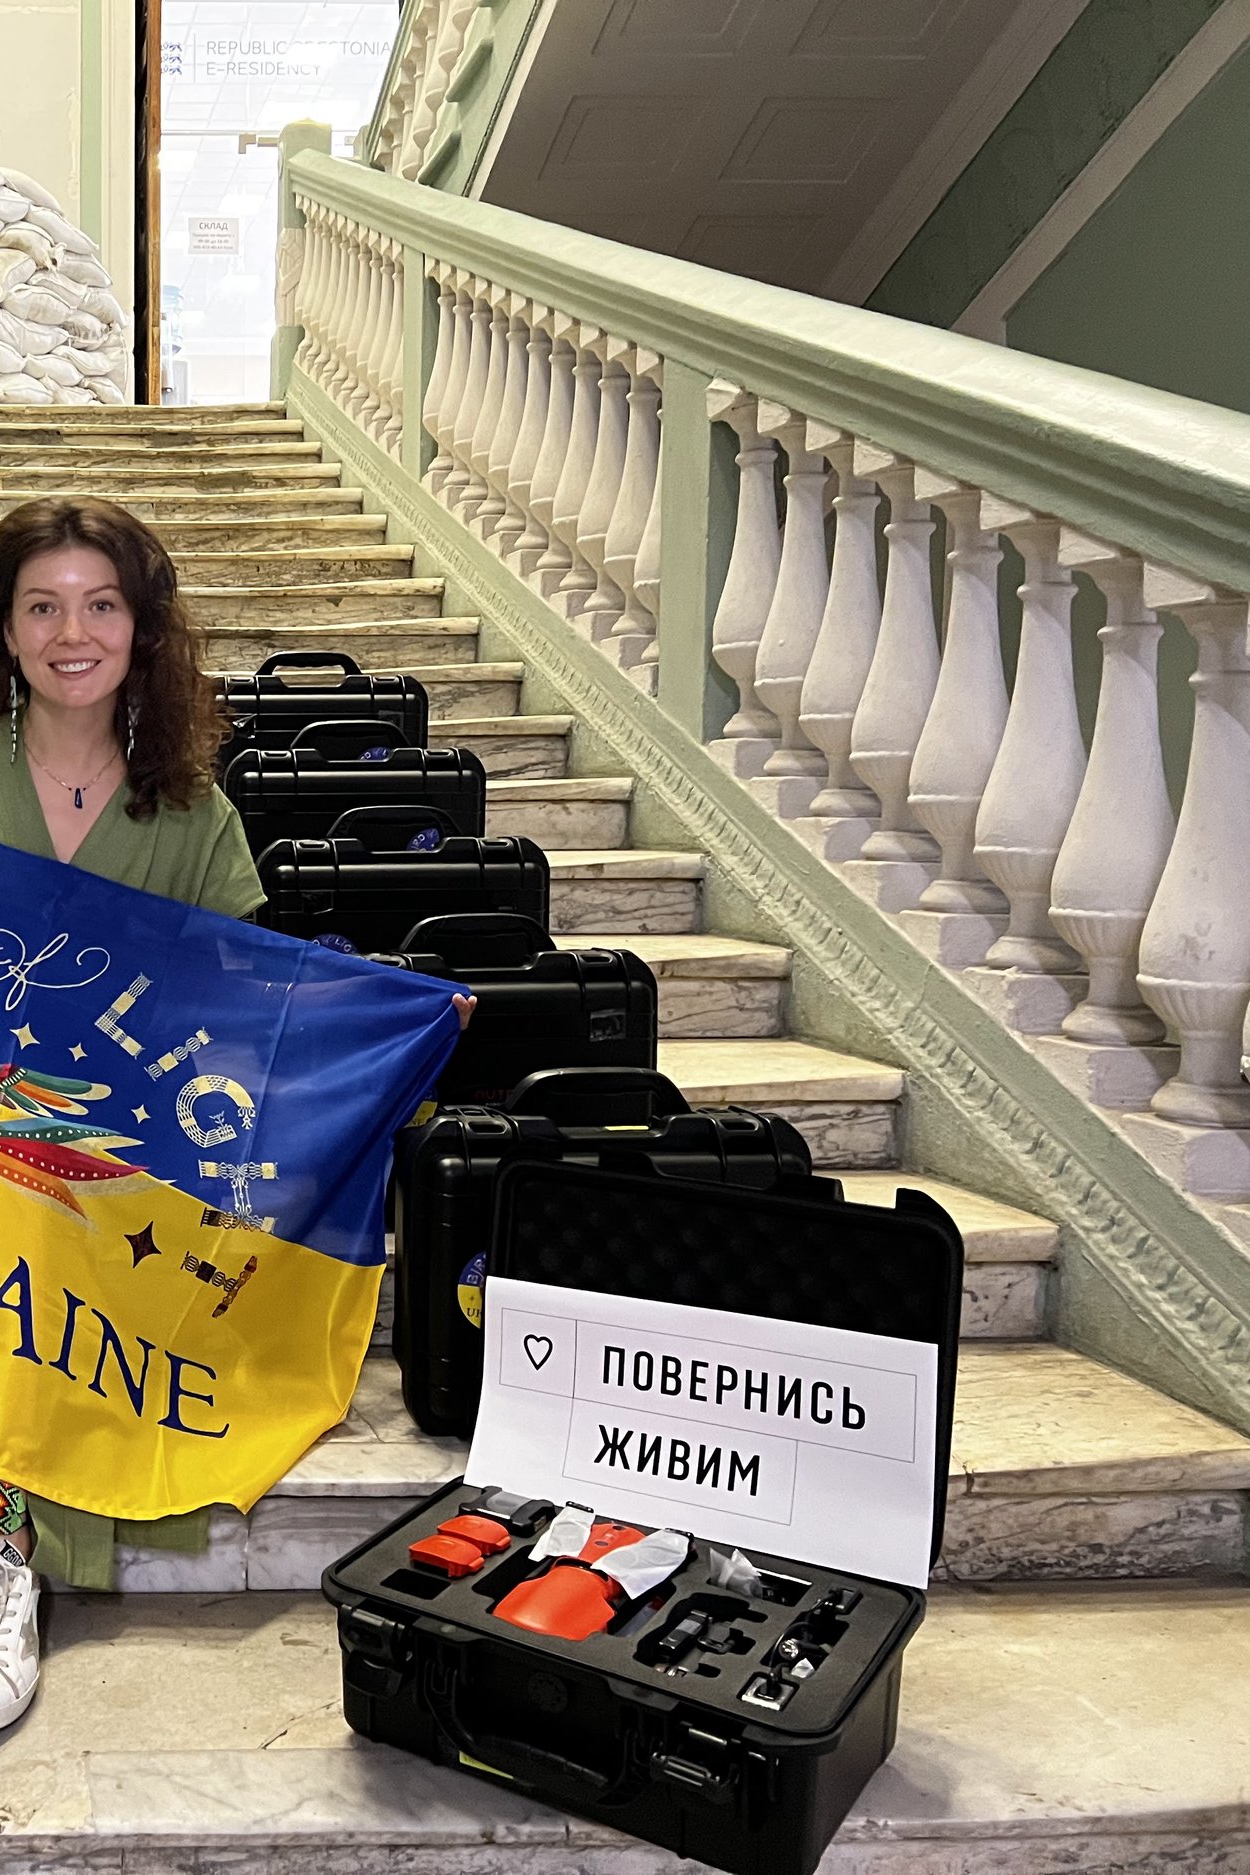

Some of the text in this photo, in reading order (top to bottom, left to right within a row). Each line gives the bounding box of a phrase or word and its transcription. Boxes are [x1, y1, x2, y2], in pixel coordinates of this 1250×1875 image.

[206, 41, 287, 55] REPUBLIC
[321, 41, 391, 56] TONIA
[206, 61, 321, 76] E-RESIDENCY
[199, 222, 229, 231] СКЛАД
[602, 1345, 866, 1430] ПОВЕРНИСЬ
[593, 1424, 760, 1496] ЖИВИМ
